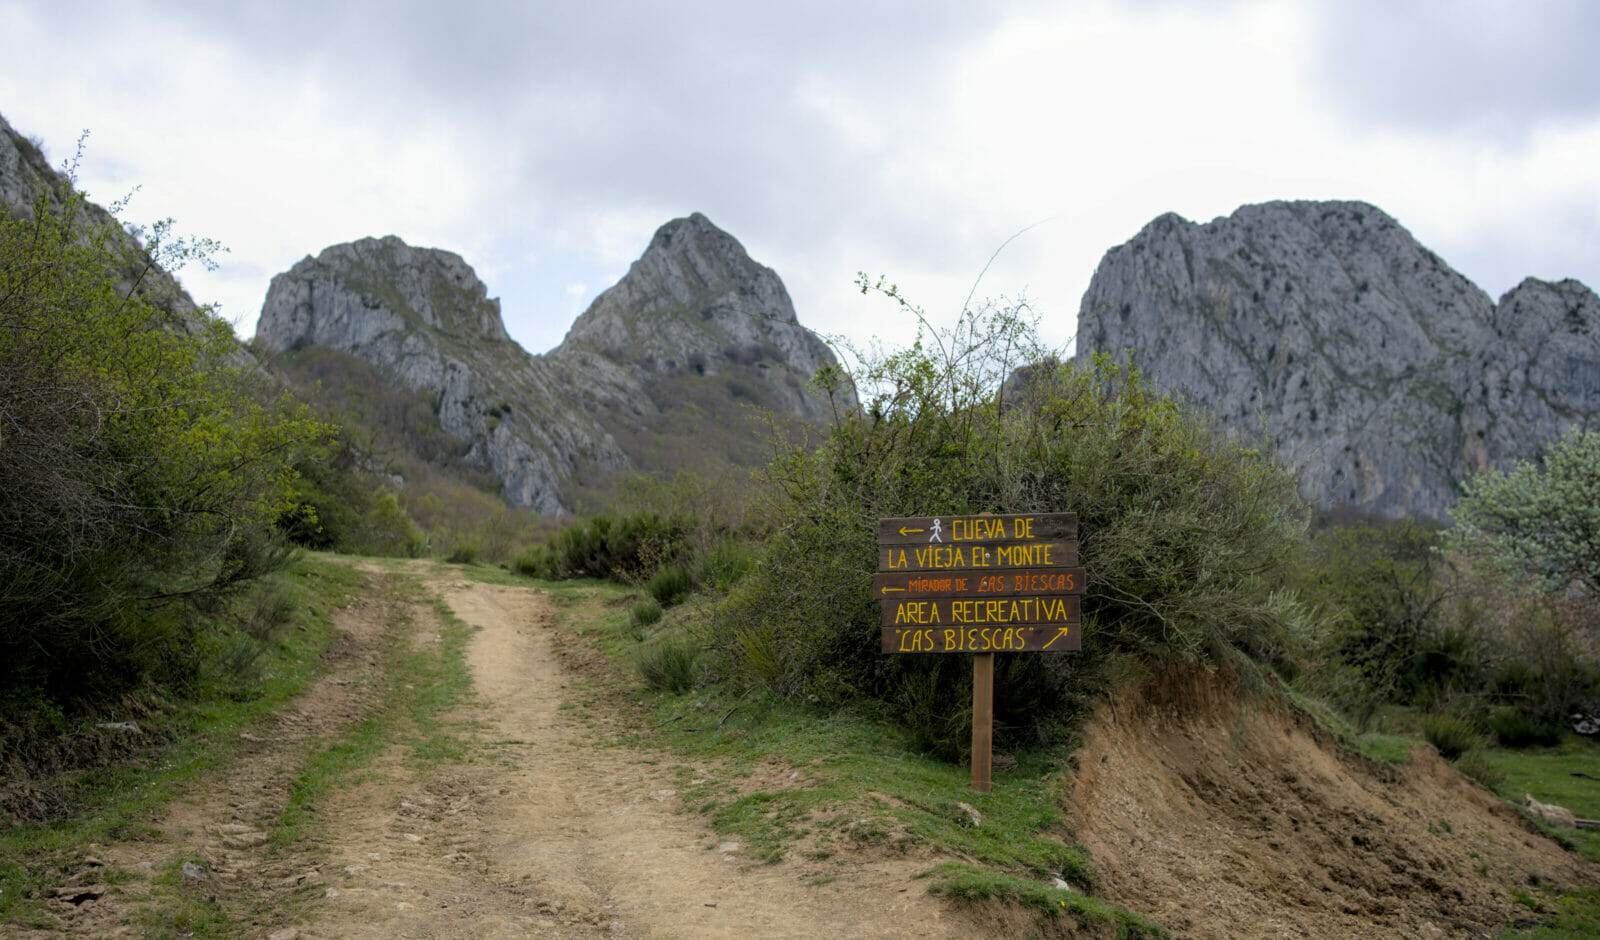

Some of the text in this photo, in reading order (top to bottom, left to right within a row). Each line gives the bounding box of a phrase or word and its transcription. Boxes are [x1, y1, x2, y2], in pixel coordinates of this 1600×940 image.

[952, 519, 1006, 541] CUEVA
[1014, 518, 1035, 538] DE
[888, 544, 1053, 569] LA VIEJA EL MONTE
[908, 571, 1075, 593] MIRADOR DE LAS BIESCAS
[895, 596, 1067, 624] AREA RECREATIVA
